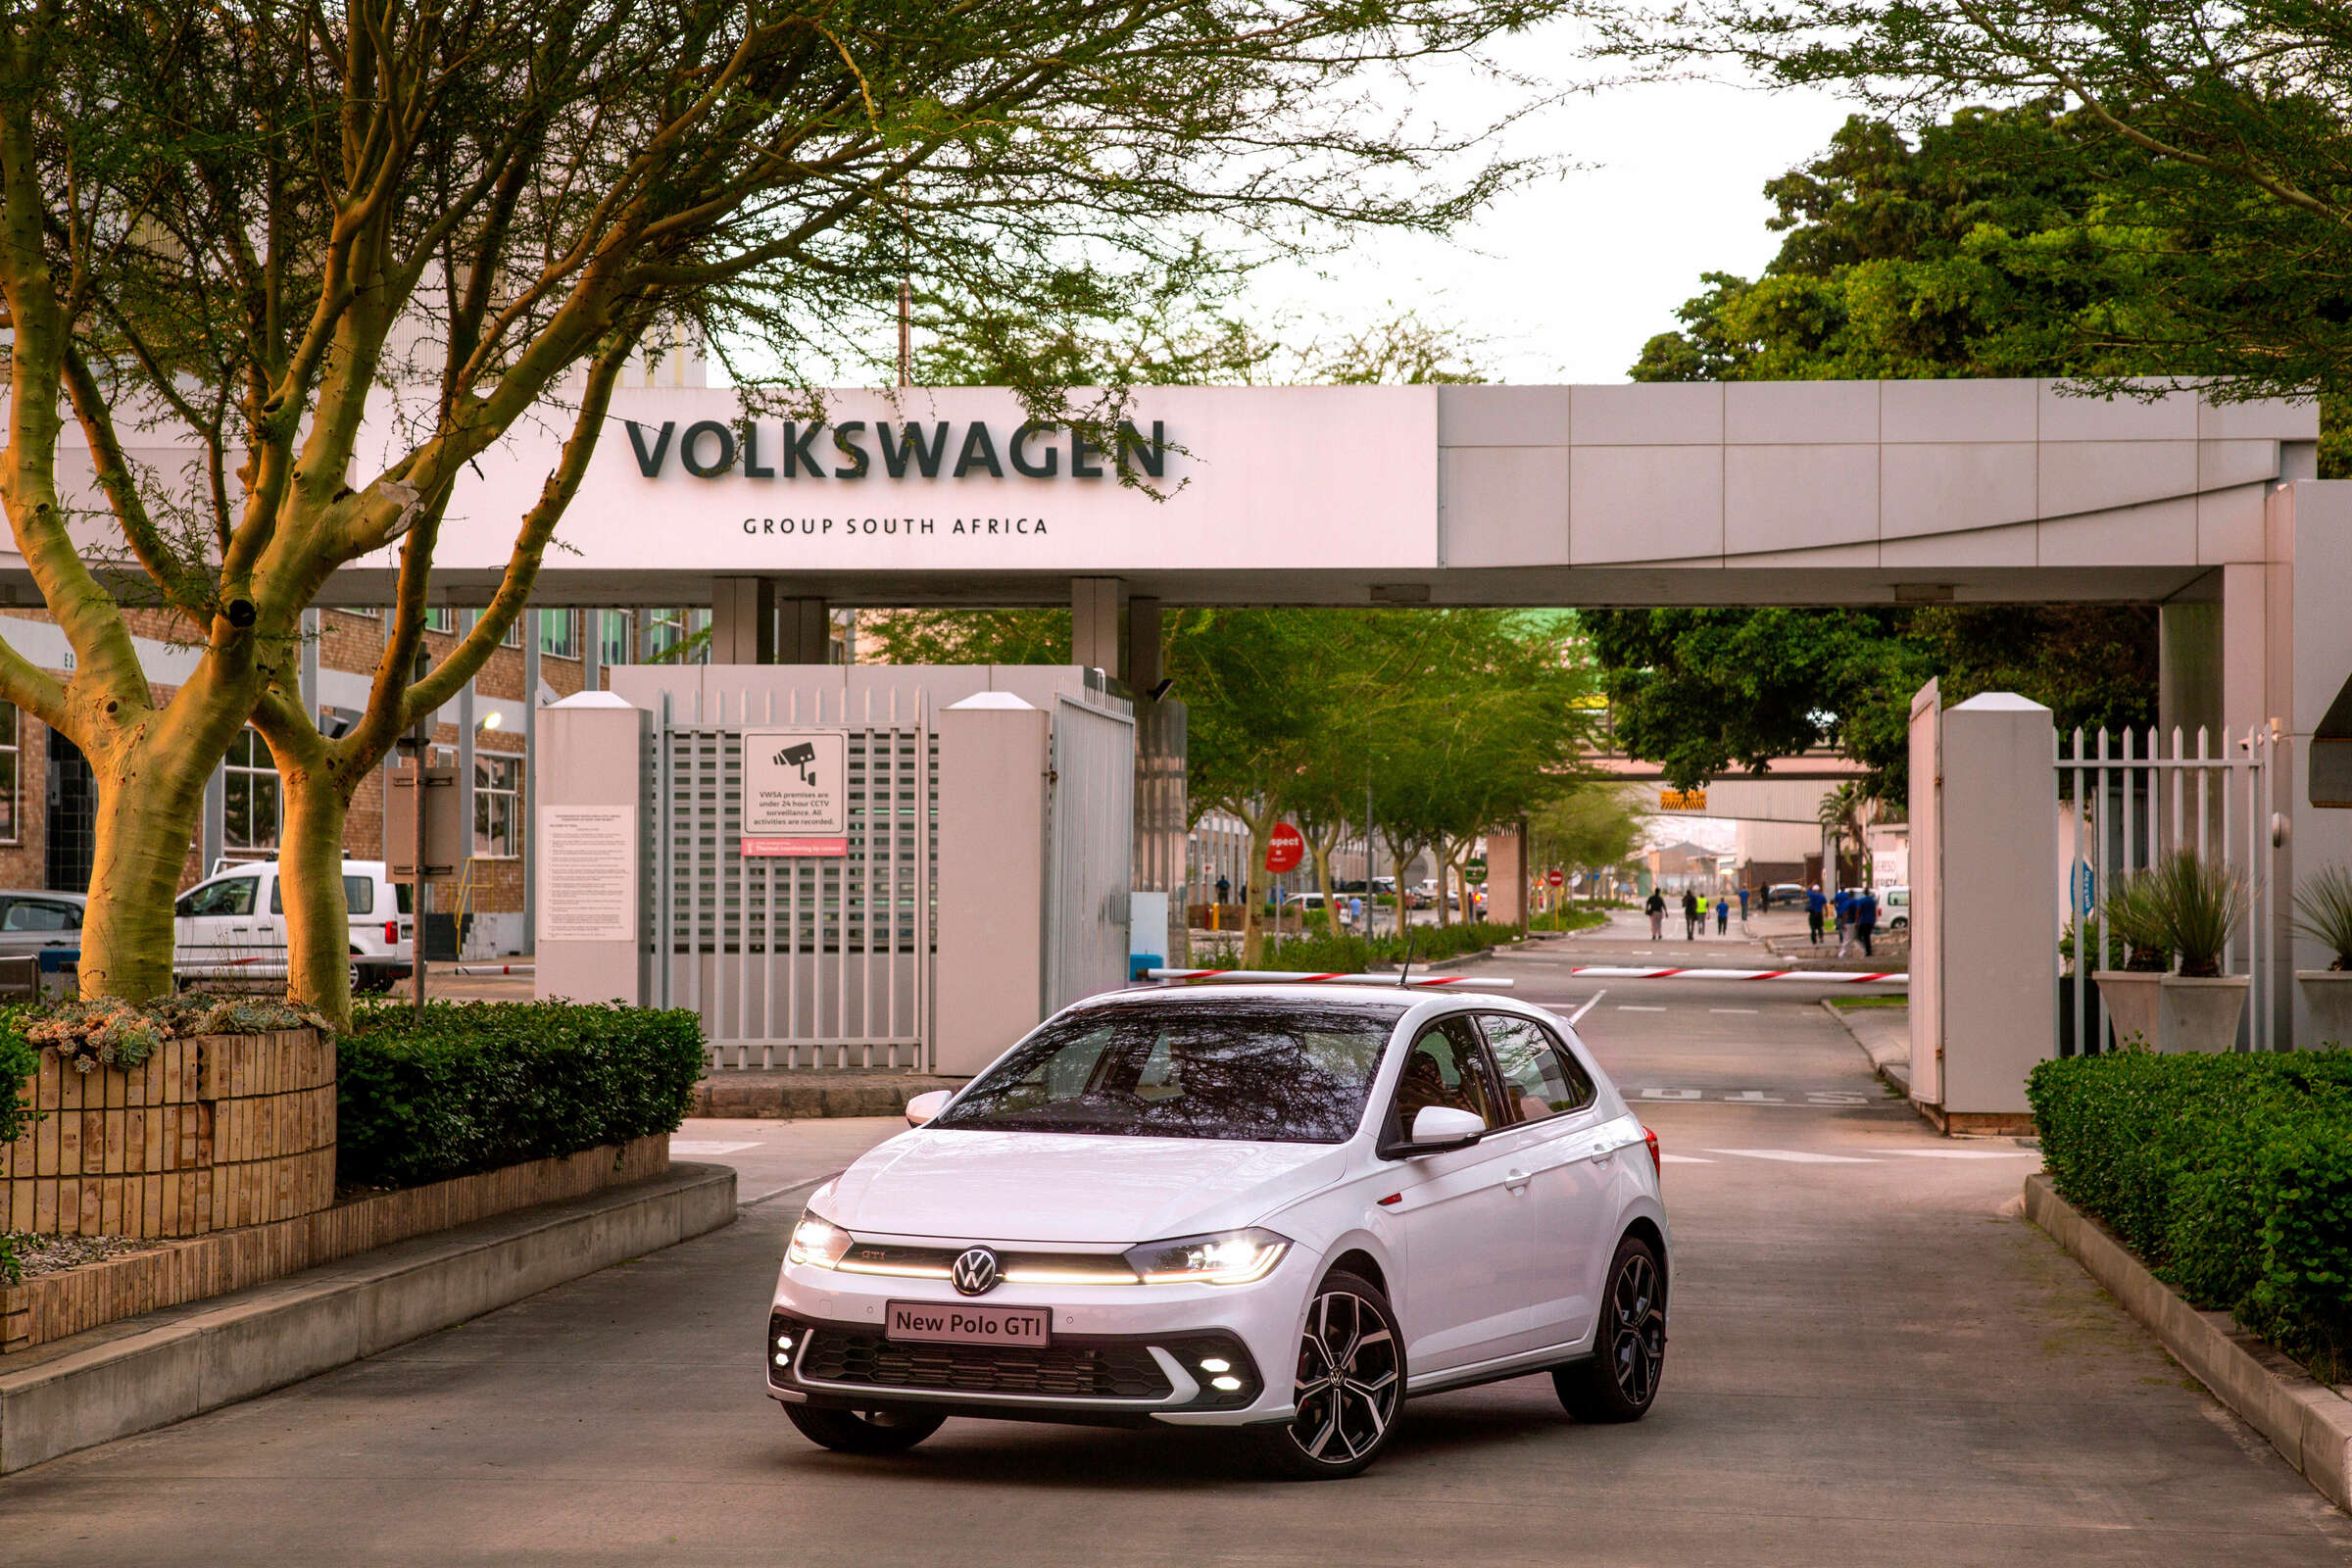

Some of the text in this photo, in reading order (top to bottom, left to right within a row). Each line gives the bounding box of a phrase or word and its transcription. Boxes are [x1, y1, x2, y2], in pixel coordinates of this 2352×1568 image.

[624, 419, 1164, 479] VOLKSWAGEN
[743, 517, 1048, 535] GROUP SOUTH AFRICA
[1269, 836, 1299, 848] spect
[861, 1250, 886, 1261] GTI
[953, 1250, 996, 1294] VW
[896, 1311, 1041, 1337] New Polo GTI
